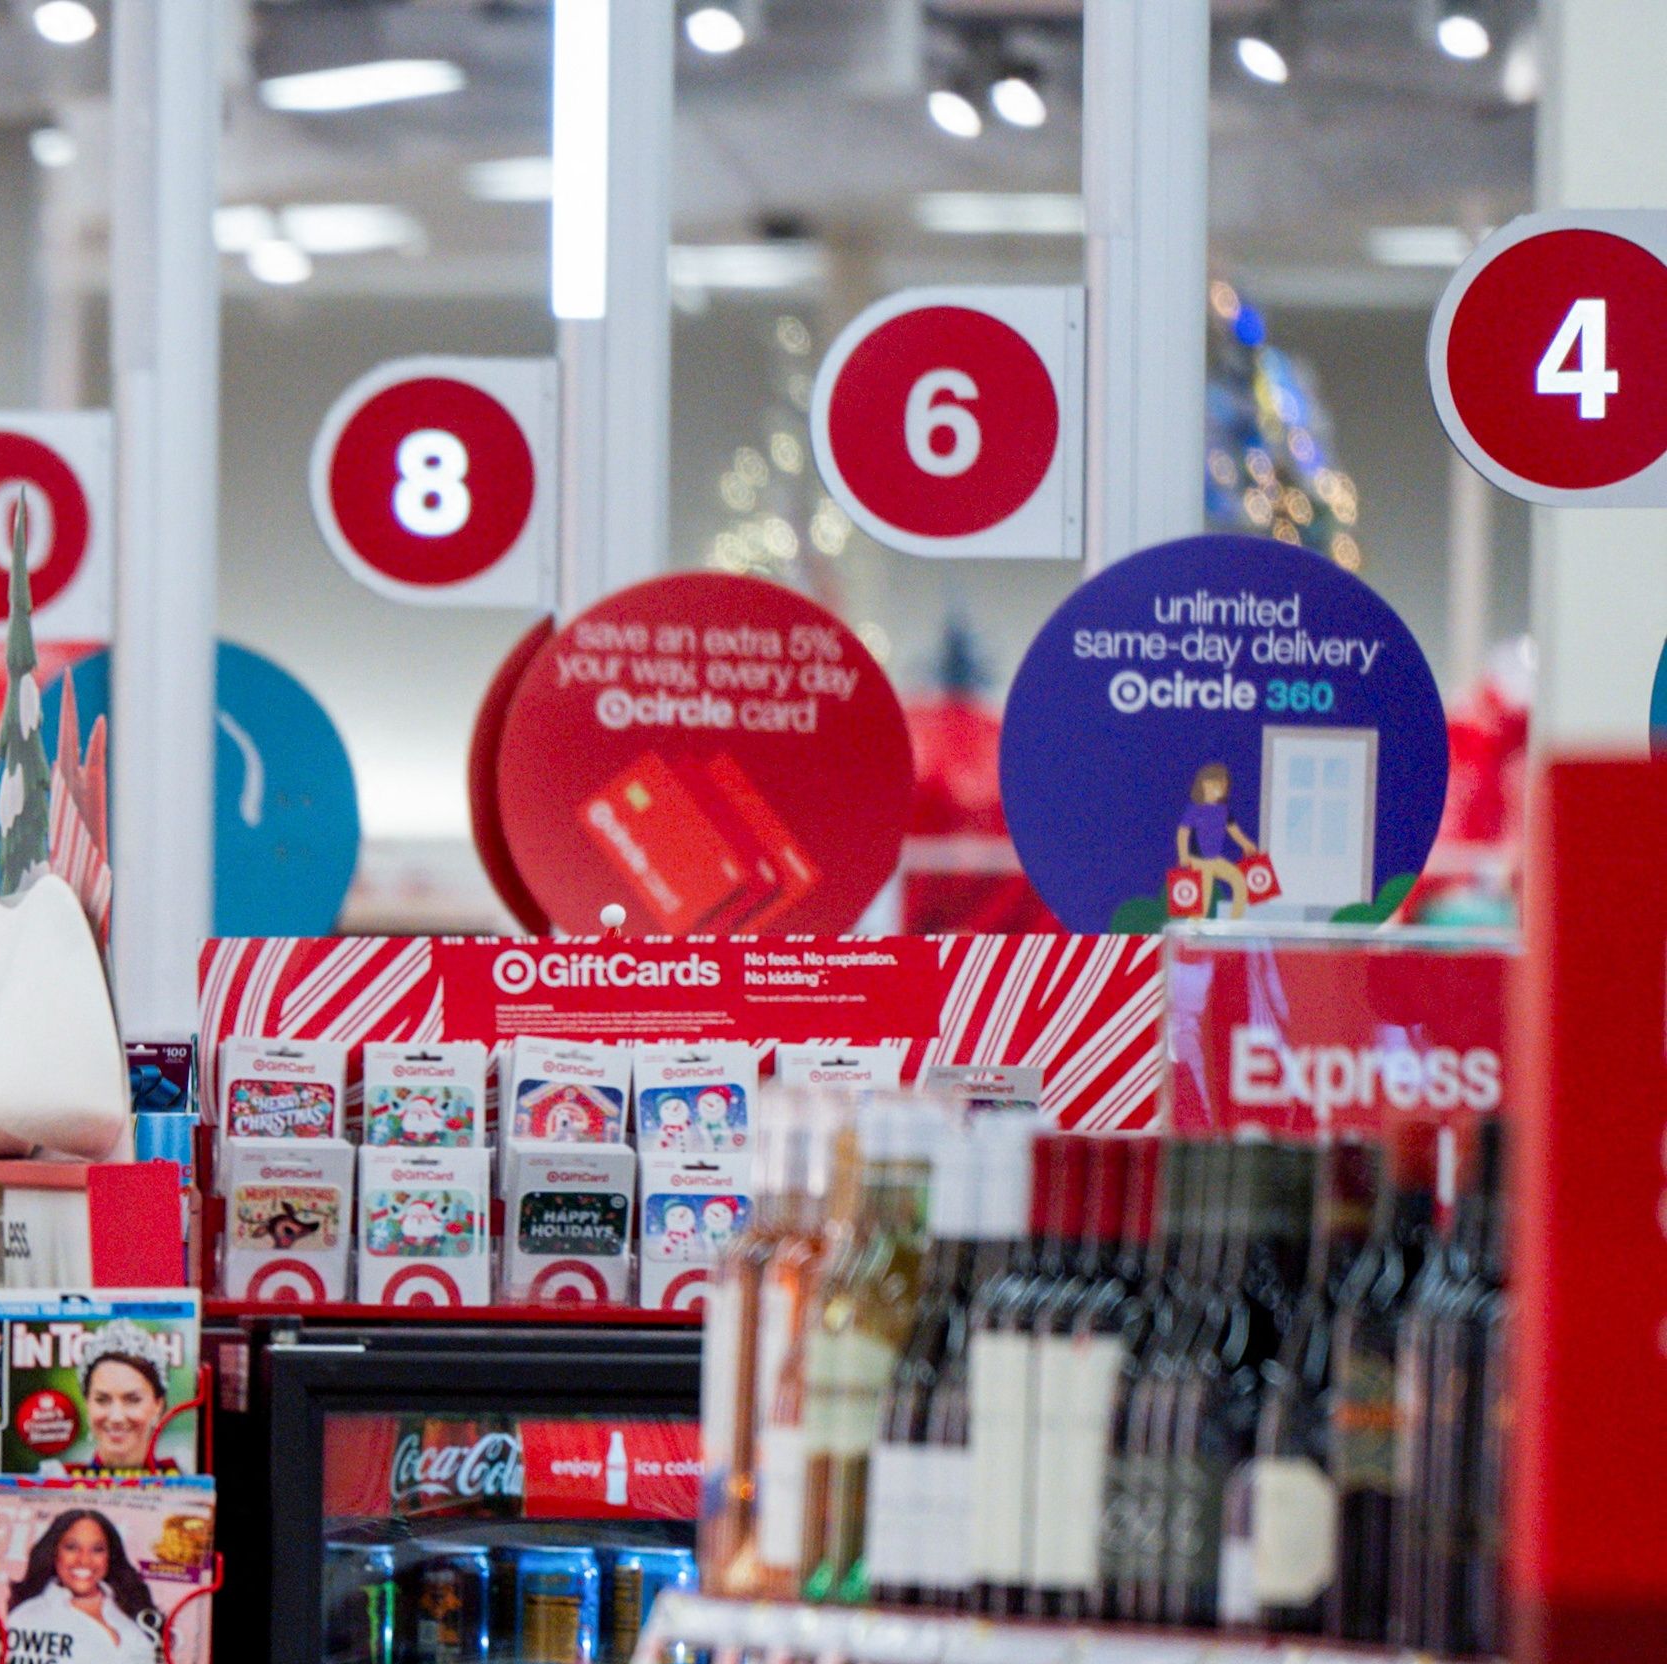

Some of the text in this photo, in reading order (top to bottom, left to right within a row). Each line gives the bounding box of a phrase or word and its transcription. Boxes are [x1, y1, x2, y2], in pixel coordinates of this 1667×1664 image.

[1536, 299, 1618, 418] 4
[905, 368, 981, 476] 6
[392, 429, 469, 537] 8
[1154, 589, 1299, 627] unlimited
[574, 622, 843, 661] save an extra 5%
[1073, 627, 1380, 675] same-day delivery
[557, 655, 620, 687] your
[706, 663, 795, 698] every
[799, 665, 859, 701] day
[1266, 679, 1334, 713] 360
[739, 699, 817, 733] card
[538, 952, 898, 987] GiftCards No fees. No expiration.
[744, 971, 766, 986] No
[1230, 1025, 1502, 1121] Express
[530, 1221, 616, 1241] HOLIDAYS
[542, 1207, 602, 1226] HAPPY
[551, 1458, 602, 1478] enjoy
[634, 1458, 662, 1475] ice
